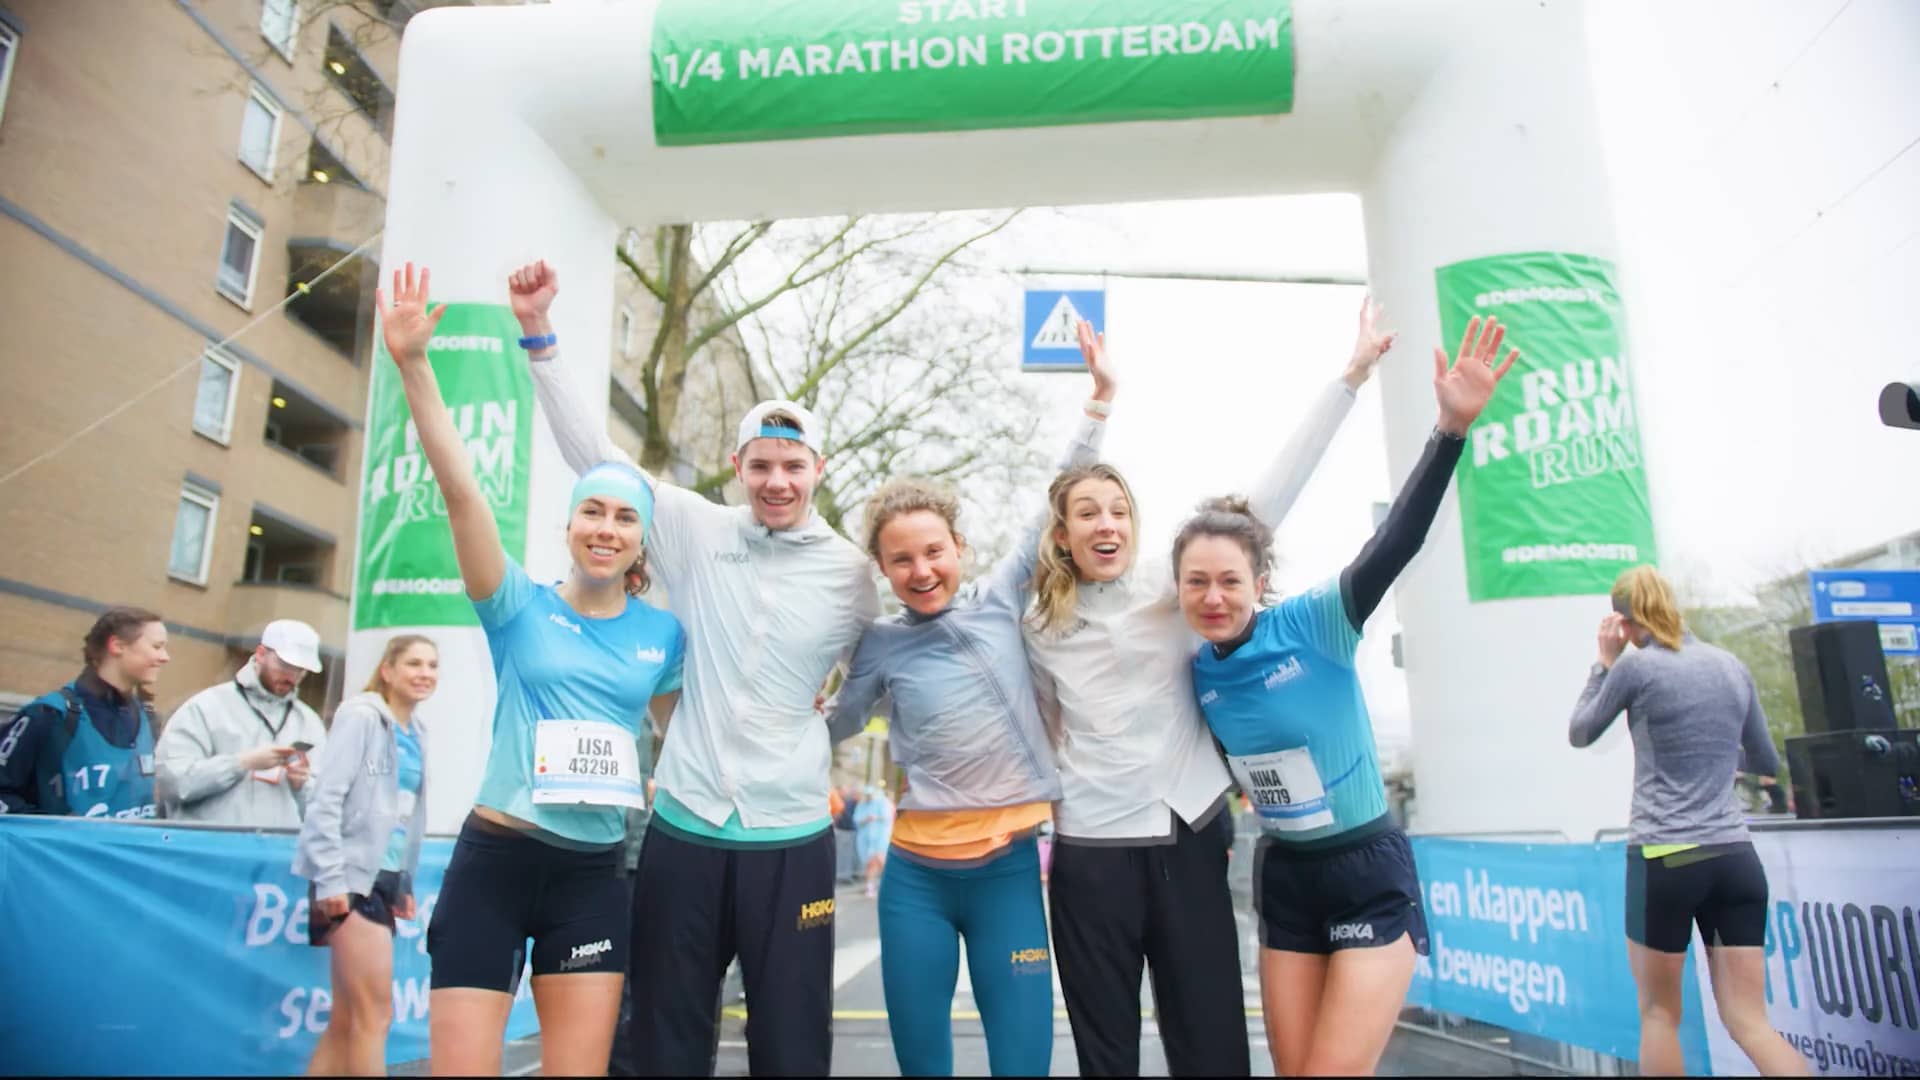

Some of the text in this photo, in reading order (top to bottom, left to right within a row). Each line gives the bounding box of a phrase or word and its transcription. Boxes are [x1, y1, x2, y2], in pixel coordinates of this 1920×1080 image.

[897, 0, 1027, 24] START
[664, 17, 1279, 89] 1/4 MARATHON ROTTERDAM
[1522, 355, 1629, 411] RUN
[1472, 393, 1634, 468] RDAM
[1529, 431, 1641, 489] RUN
[577, 738, 613, 756] LISA
[74, 764, 111, 790] 17
[568, 758, 619, 776] 43298
[1249, 769, 1283, 787] NINA
[1430, 880, 1461, 917] en
[1465, 868, 1588, 943] klappen
[1330, 923, 1375, 941] HOKA
[571, 939, 612, 959] HOKA
[1435, 931, 1566, 1013] bewegen
